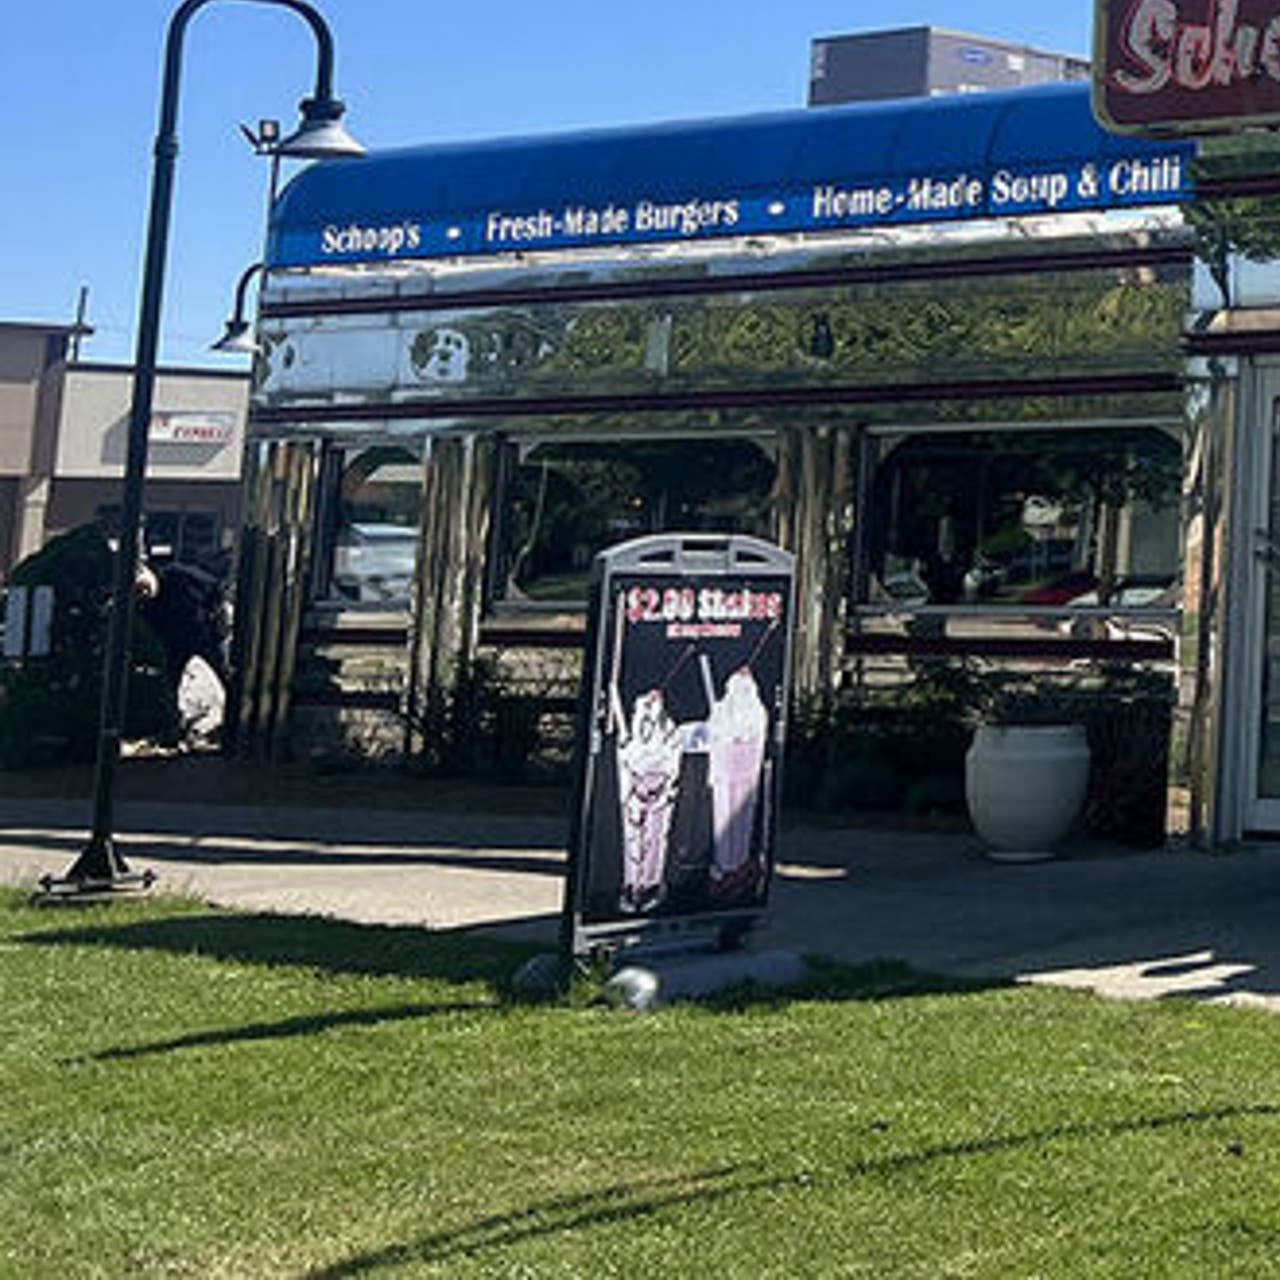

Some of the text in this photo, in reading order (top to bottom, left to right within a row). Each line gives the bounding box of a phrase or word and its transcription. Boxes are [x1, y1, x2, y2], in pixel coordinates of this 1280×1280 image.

[320, 156, 1181, 255] Schoop's Fresh-Made Burgers Home-Made Soup & Chili
